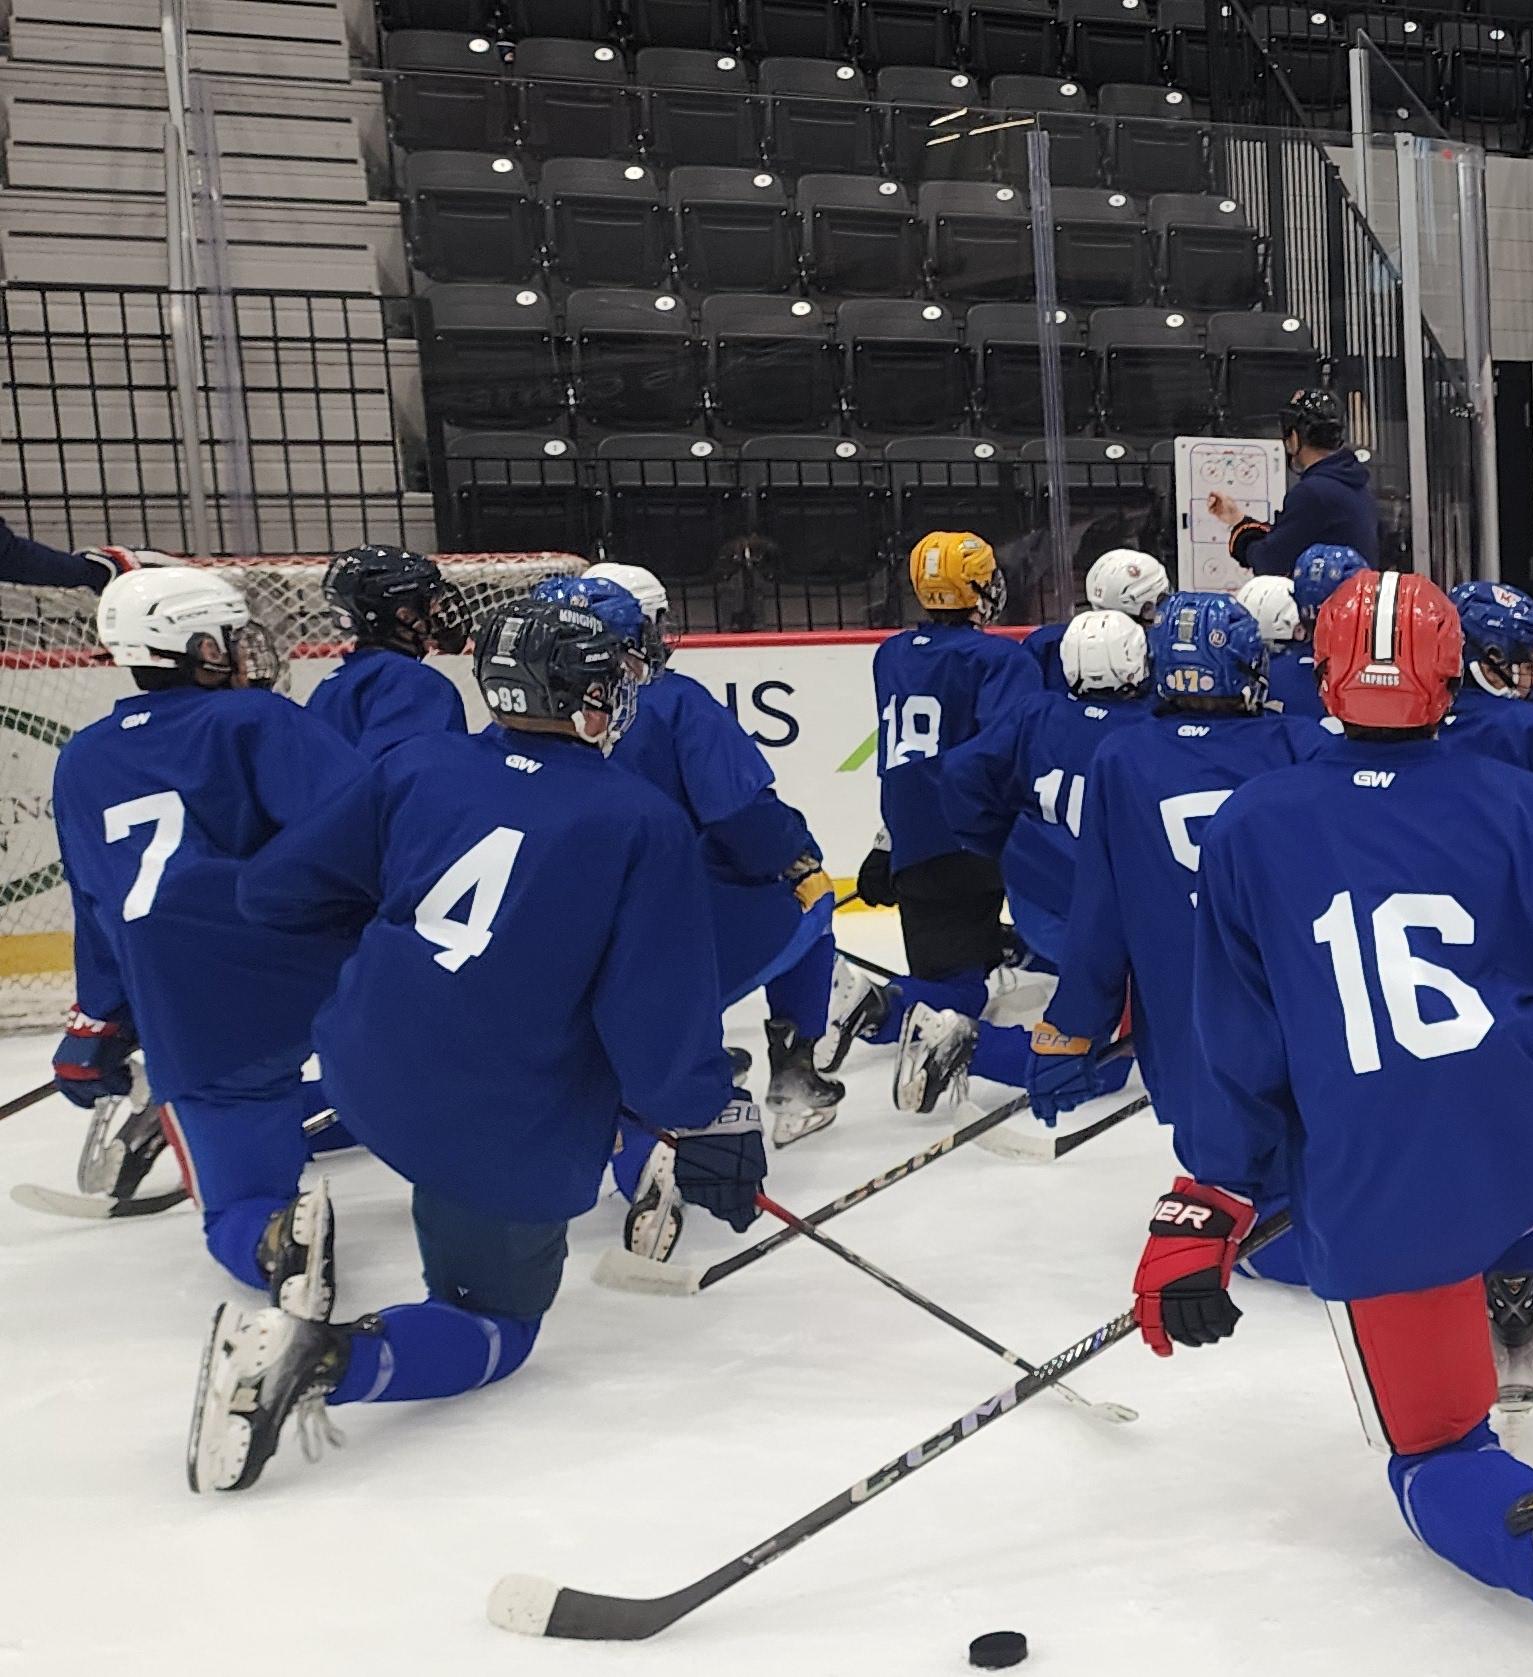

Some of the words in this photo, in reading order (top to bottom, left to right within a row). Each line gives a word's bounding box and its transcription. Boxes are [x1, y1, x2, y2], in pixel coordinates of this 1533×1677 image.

[498, 686, 528, 713] 93
[1174, 669, 1199, 692] 17
[1353, 769, 1396, 789] GW
[103, 789, 186, 922] 7
[415, 827, 525, 973] 4
[1313, 889, 1496, 1076] 16
[850, 1380, 1018, 1504] CCM
